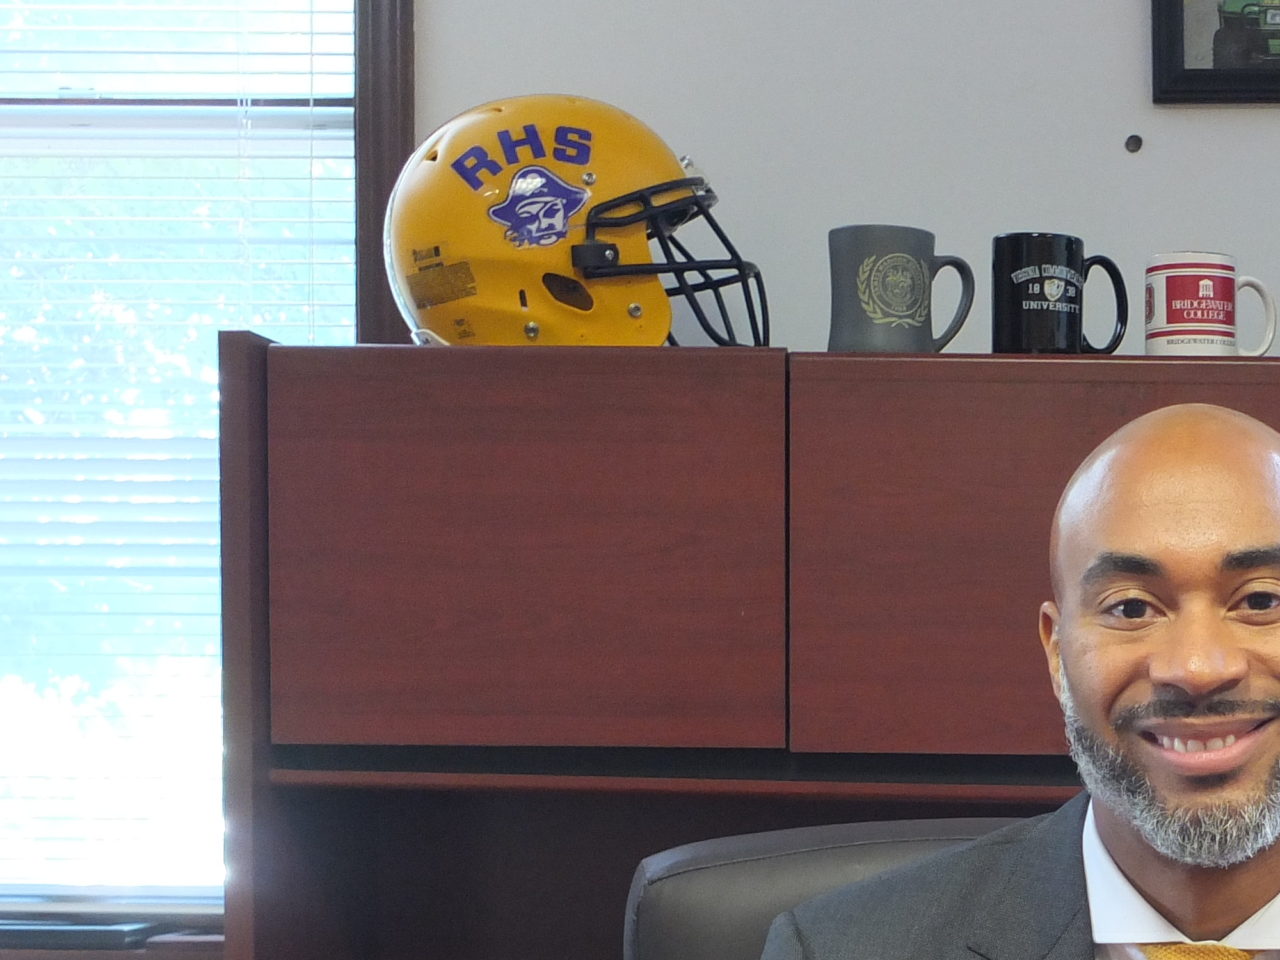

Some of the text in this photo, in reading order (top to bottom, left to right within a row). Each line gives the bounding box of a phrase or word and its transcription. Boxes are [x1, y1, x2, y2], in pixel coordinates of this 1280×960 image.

[451, 124, 592, 191] RHS
[1171, 299, 1234, 313] BRIDGEWATER
[1183, 309, 1227, 320] COLLEGE
